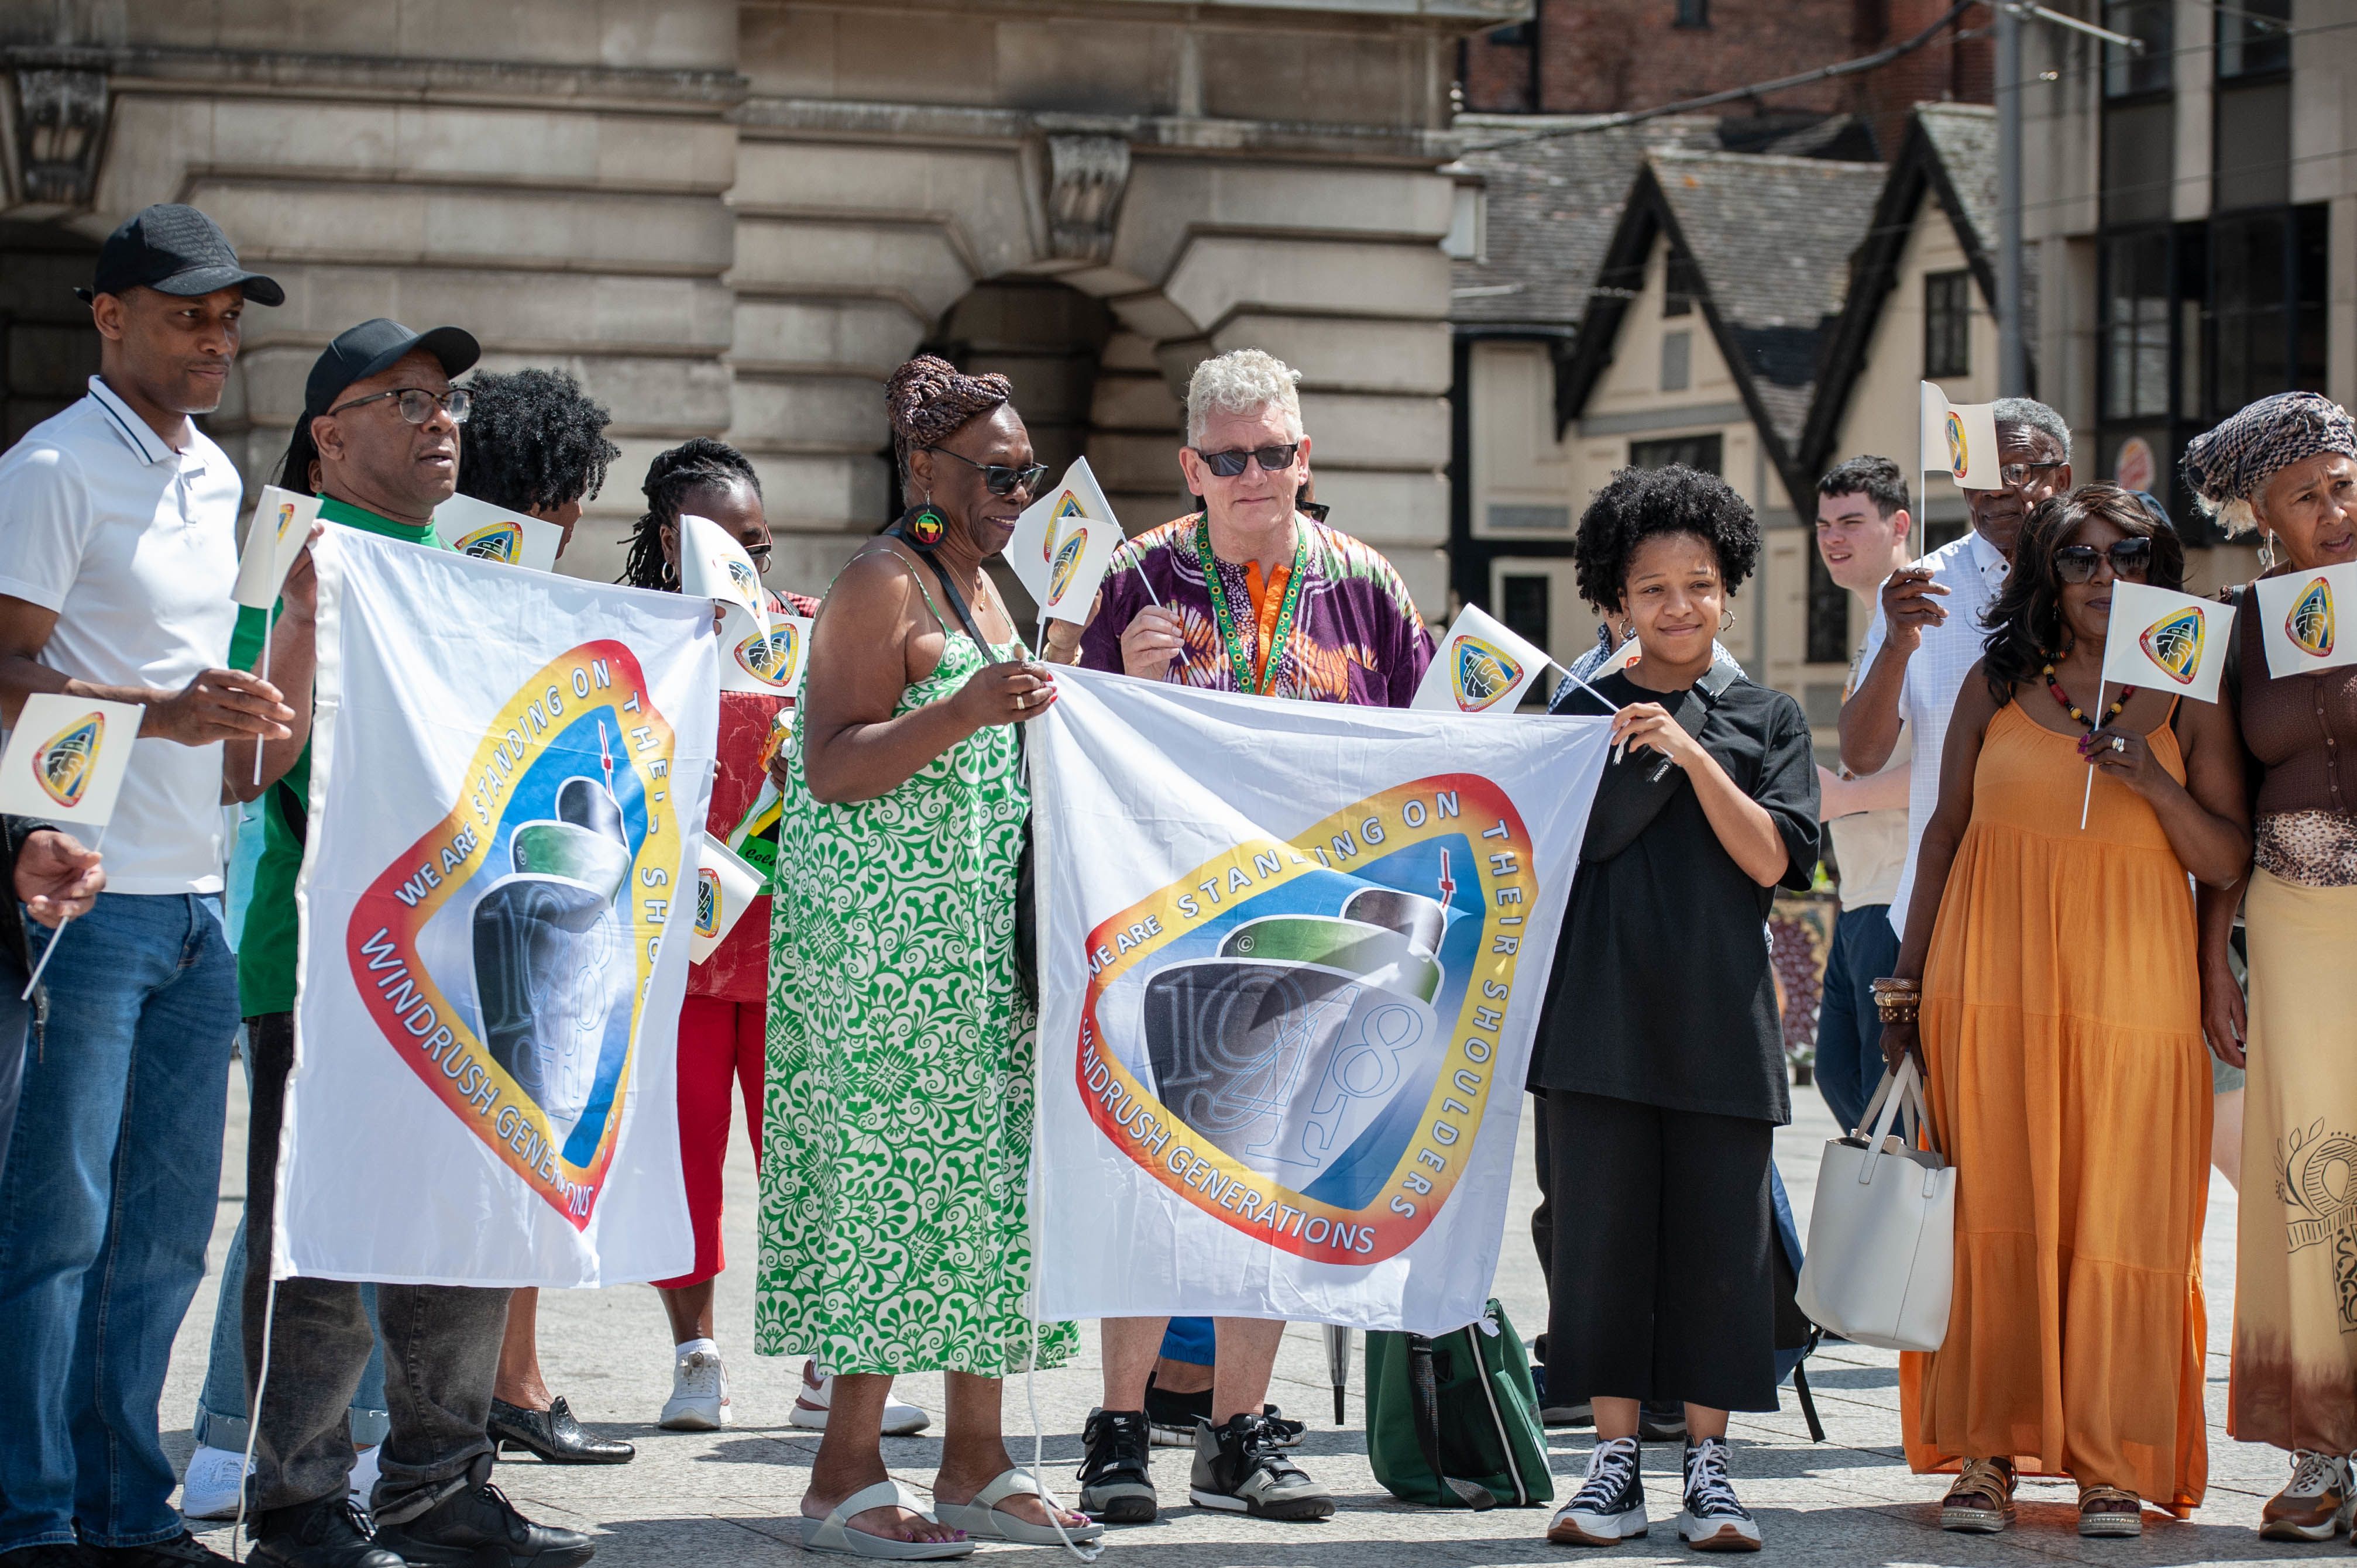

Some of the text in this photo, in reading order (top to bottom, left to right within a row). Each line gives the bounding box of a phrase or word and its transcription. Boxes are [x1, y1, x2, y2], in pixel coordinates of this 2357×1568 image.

[393, 862, 442, 907] WE
[440, 821, 479, 874] ARE
[472, 685, 564, 825] STANDING
[571, 658, 611, 698] ON
[1402, 790, 1461, 828] ON
[1653, 764, 1669, 782] SINNO
[1115, 914, 1163, 955] ARE
[1482, 819, 1523, 956] THEIR
[359, 926, 500, 1116] WINDRUSH
[1390, 979, 1509, 1219] SHOULDERS
[1166, 1144, 1376, 1254] GENERATIONS
